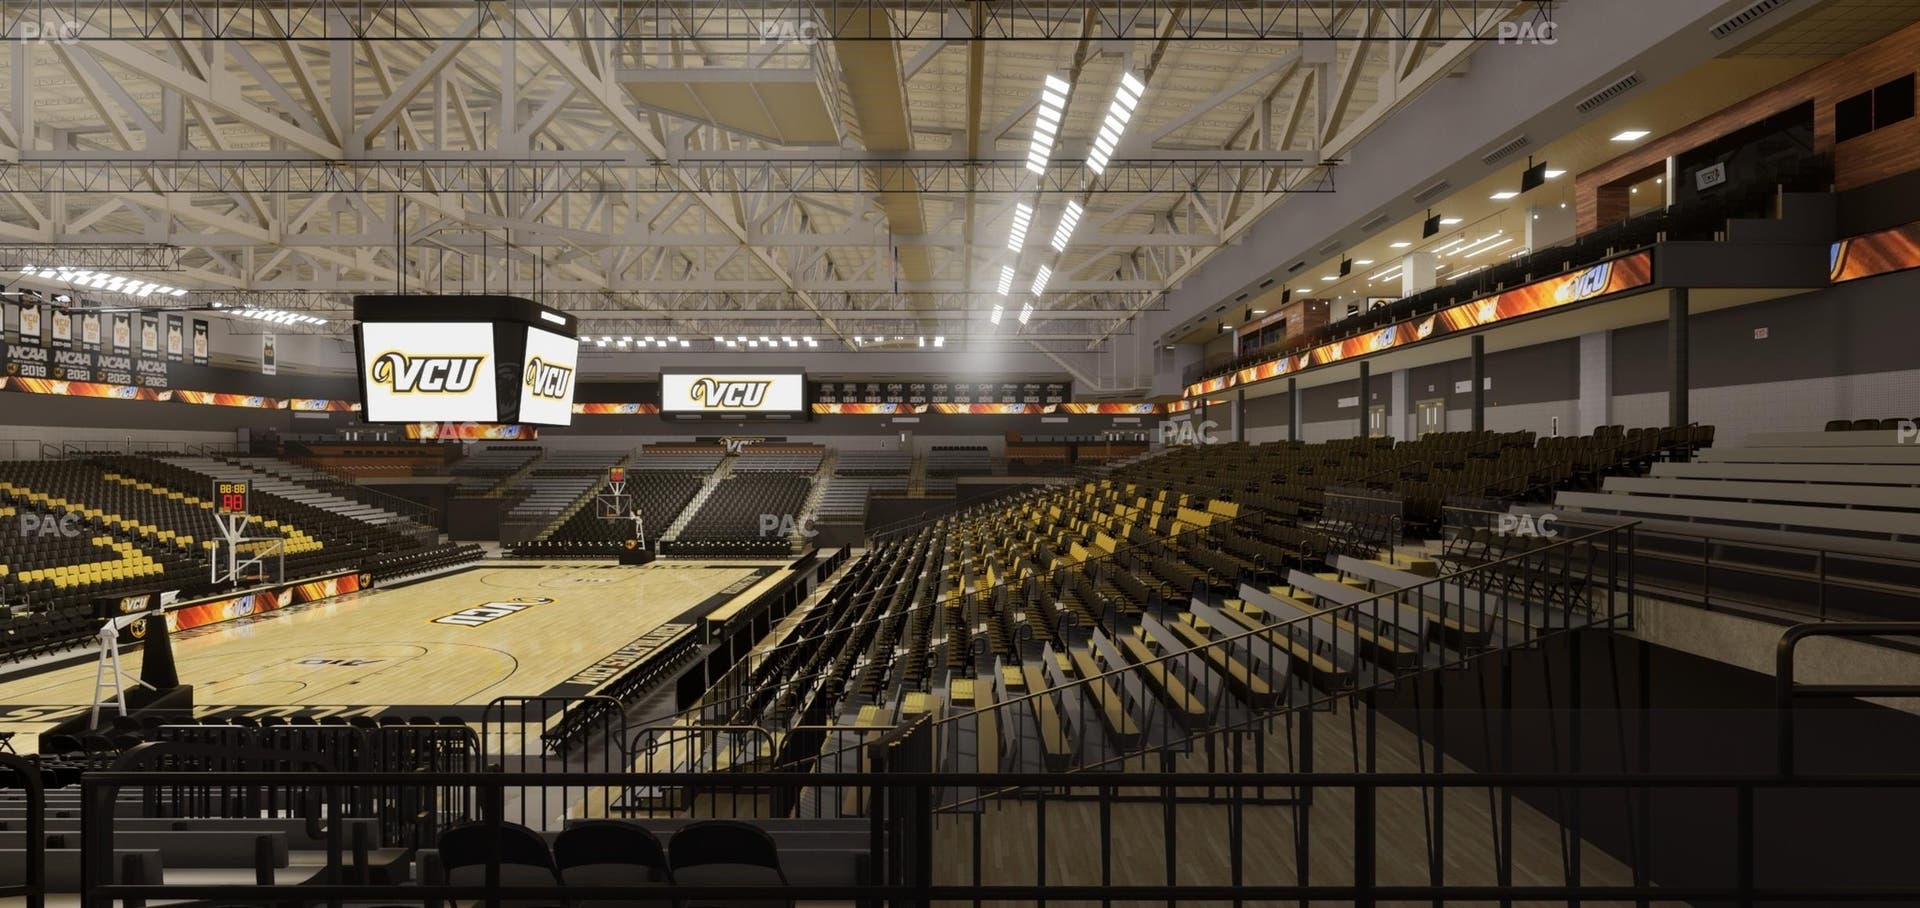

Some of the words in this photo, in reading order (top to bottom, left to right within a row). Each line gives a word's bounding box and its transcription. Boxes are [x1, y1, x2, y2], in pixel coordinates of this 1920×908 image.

[7, 345, 48, 362] NCAA
[54, 350, 92, 366] NCAA
[21, 364, 47, 378] 2019
[97, 354, 131, 371] NCAA
[136, 359, 168, 374] NCAA
[67, 368, 91, 381] 2021
[107, 372, 132, 384] 2023
[372, 351, 485, 393] VCU
[526, 357, 572, 399] VCU
[145, 376, 168, 388] 2025
[691, 377, 772, 407] VCU
[121, 594, 151, 613] VCU
[431, 597, 554, 628] VCU
